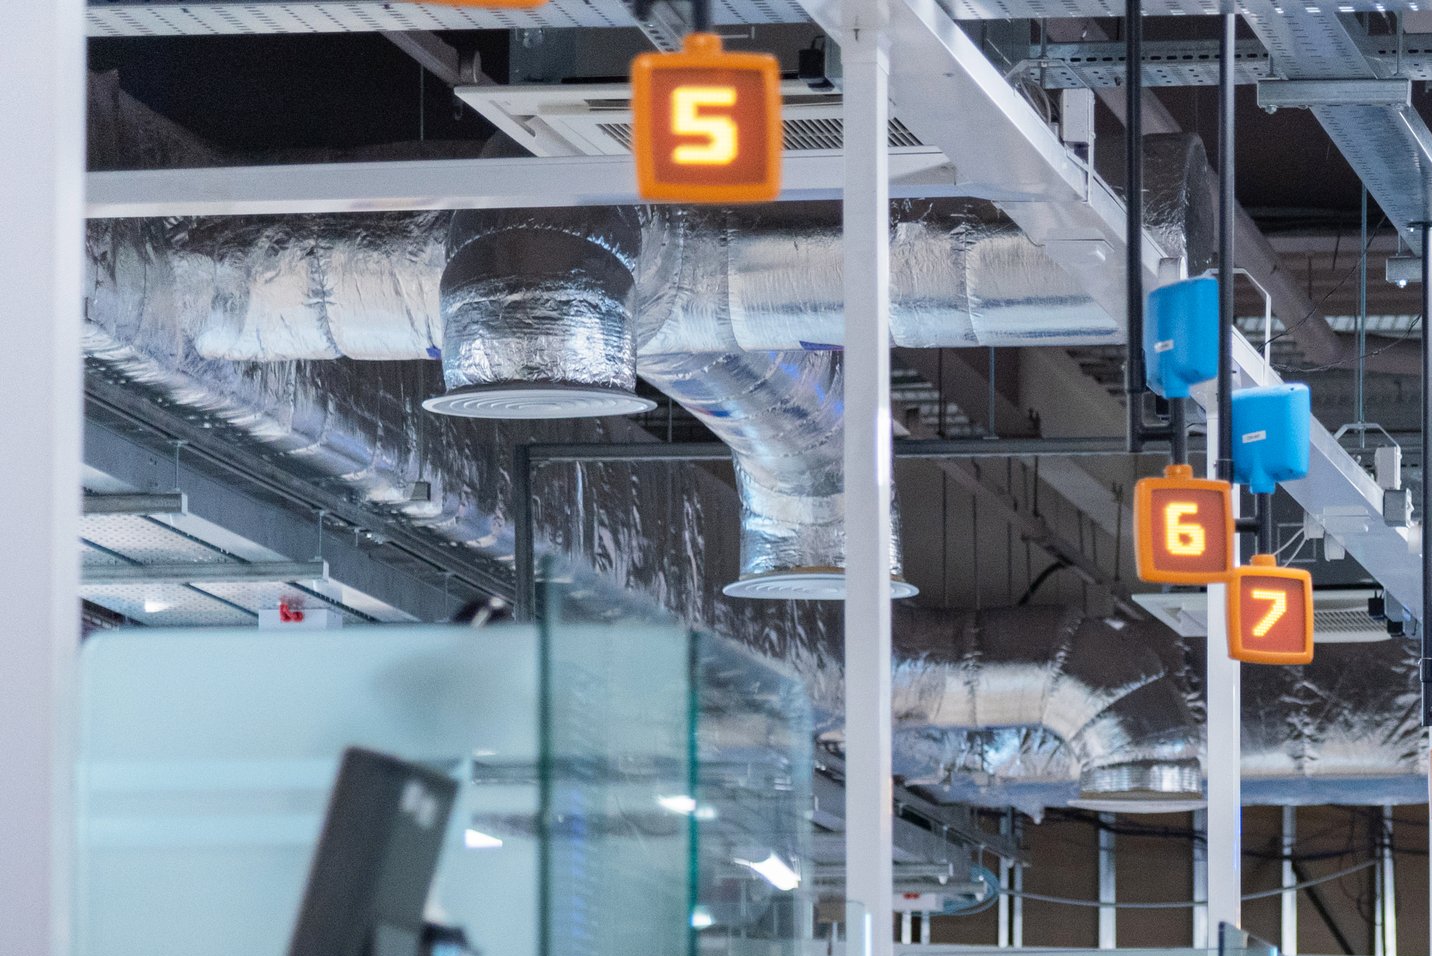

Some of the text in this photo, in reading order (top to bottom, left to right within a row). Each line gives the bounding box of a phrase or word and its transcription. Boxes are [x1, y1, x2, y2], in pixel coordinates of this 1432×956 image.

[671, 85, 738, 165] 5
[1164, 502, 1205, 556] 6
[1250, 589, 1287, 637] 7
